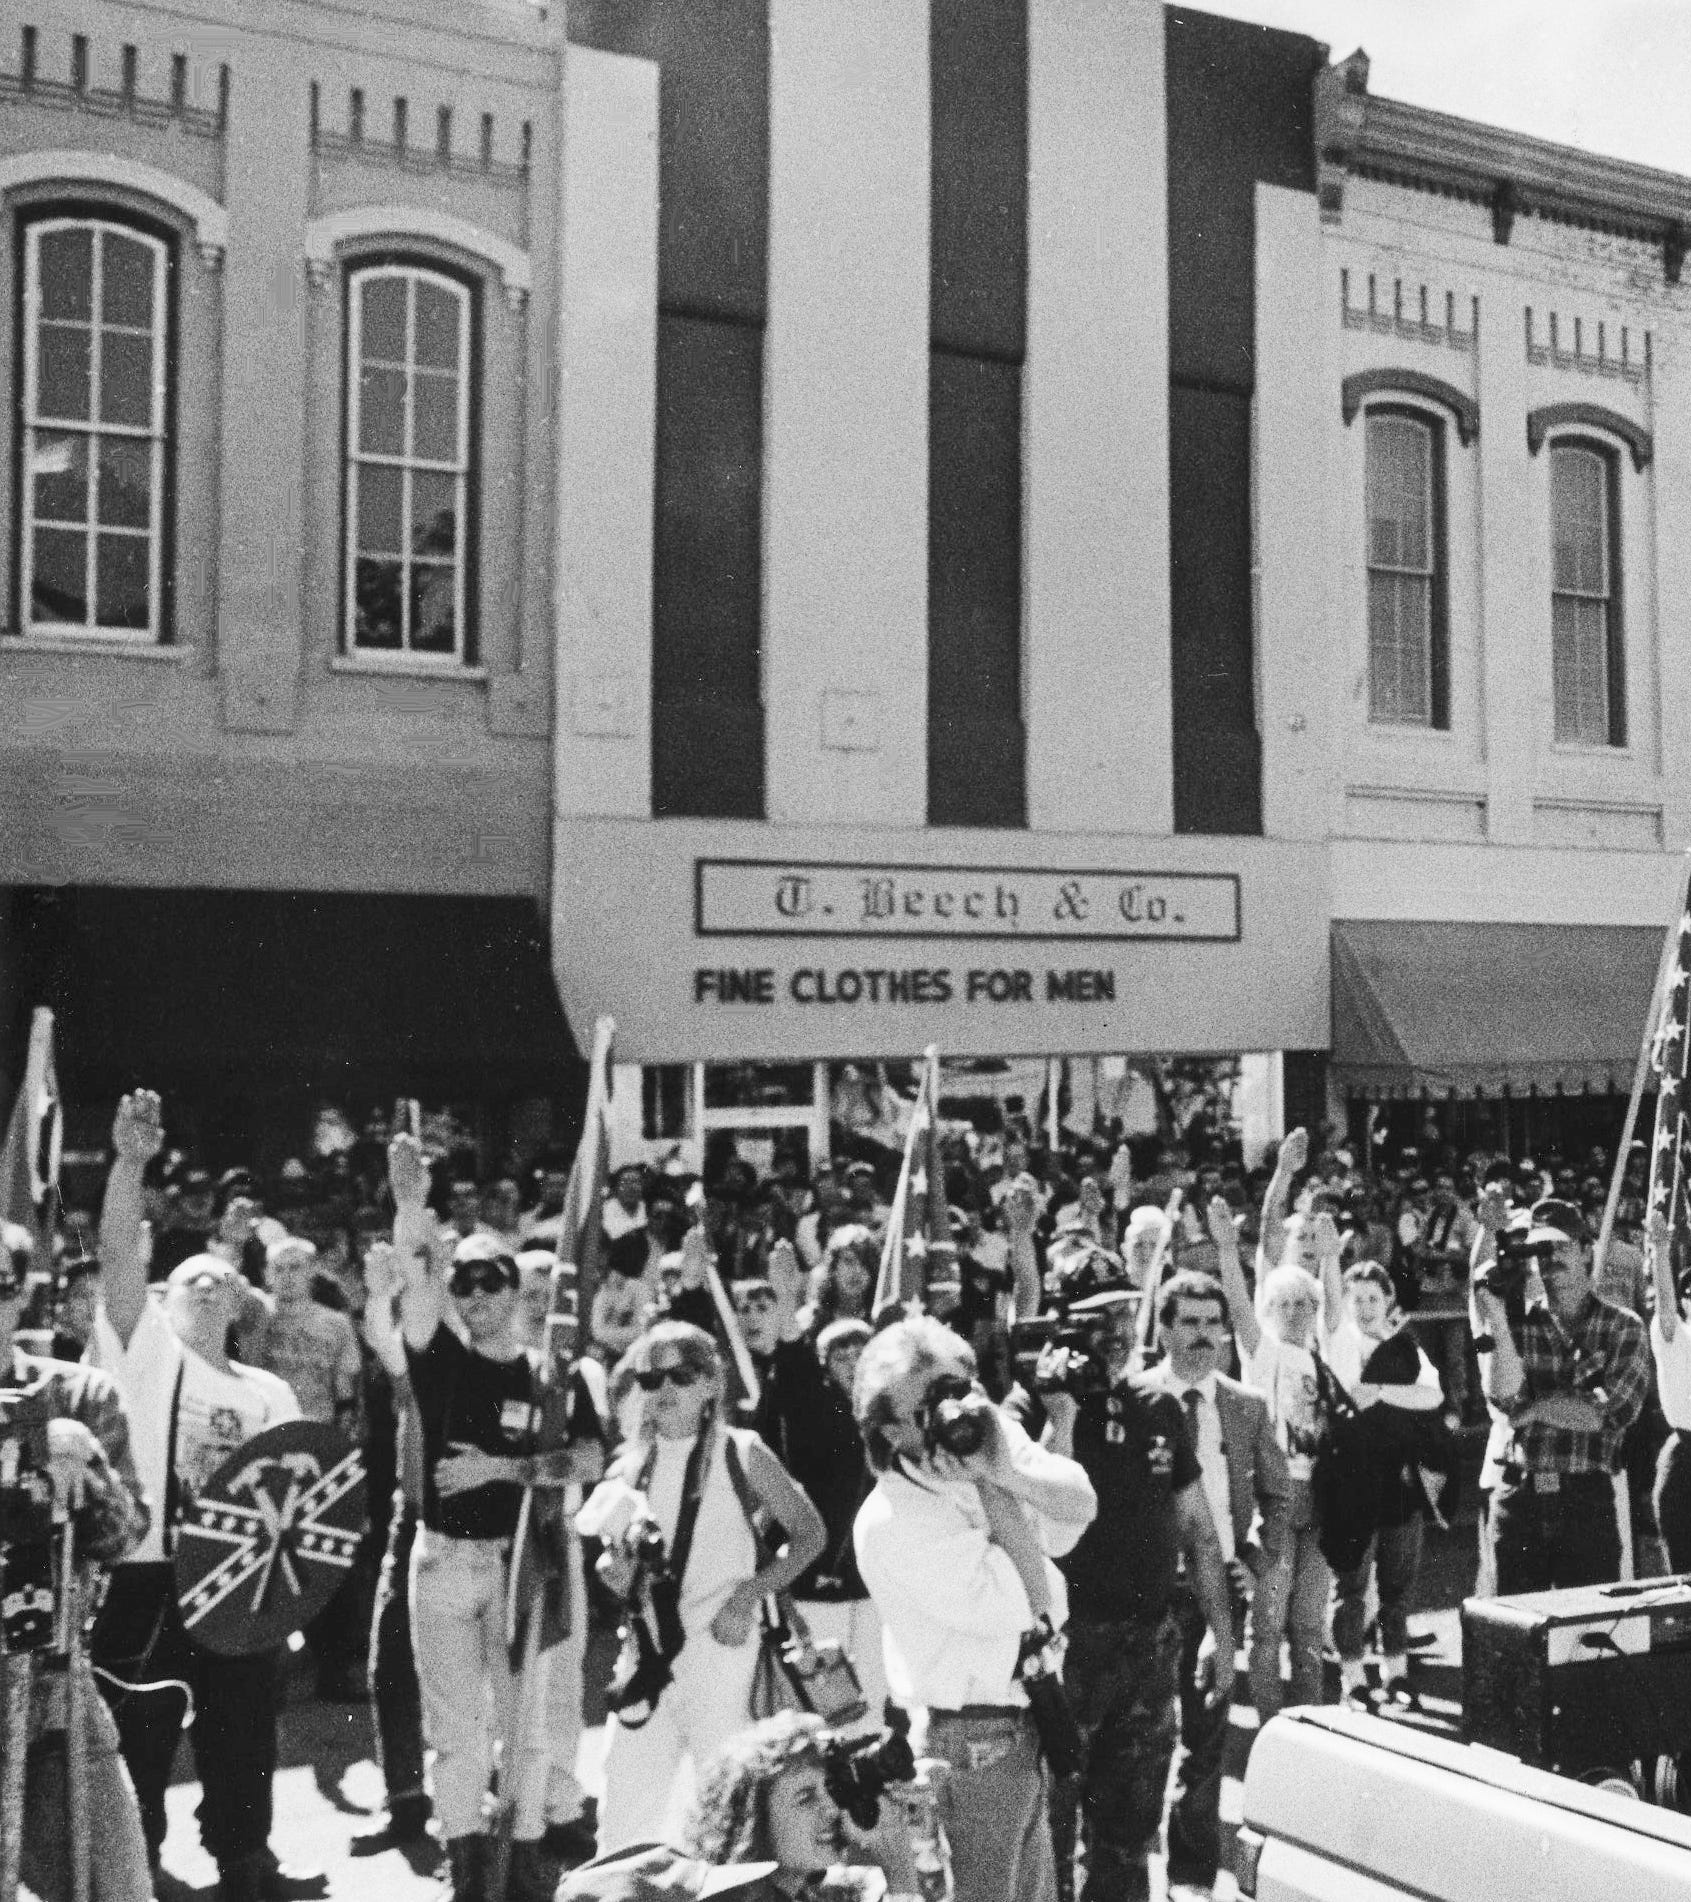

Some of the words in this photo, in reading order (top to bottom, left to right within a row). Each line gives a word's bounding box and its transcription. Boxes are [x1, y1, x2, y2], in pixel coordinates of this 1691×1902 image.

[775, 875, 834, 917] T.
[860, 878, 1019, 928] Beech
[1054, 881, 1090, 921] &
[1119, 885, 1185, 923] Co.
[694, 968, 775, 1003] FINE
[790, 968, 953, 1003] CLOTHES
[967, 969, 1032, 1003] FOR
[1046, 969, 1116, 1003] MEN
